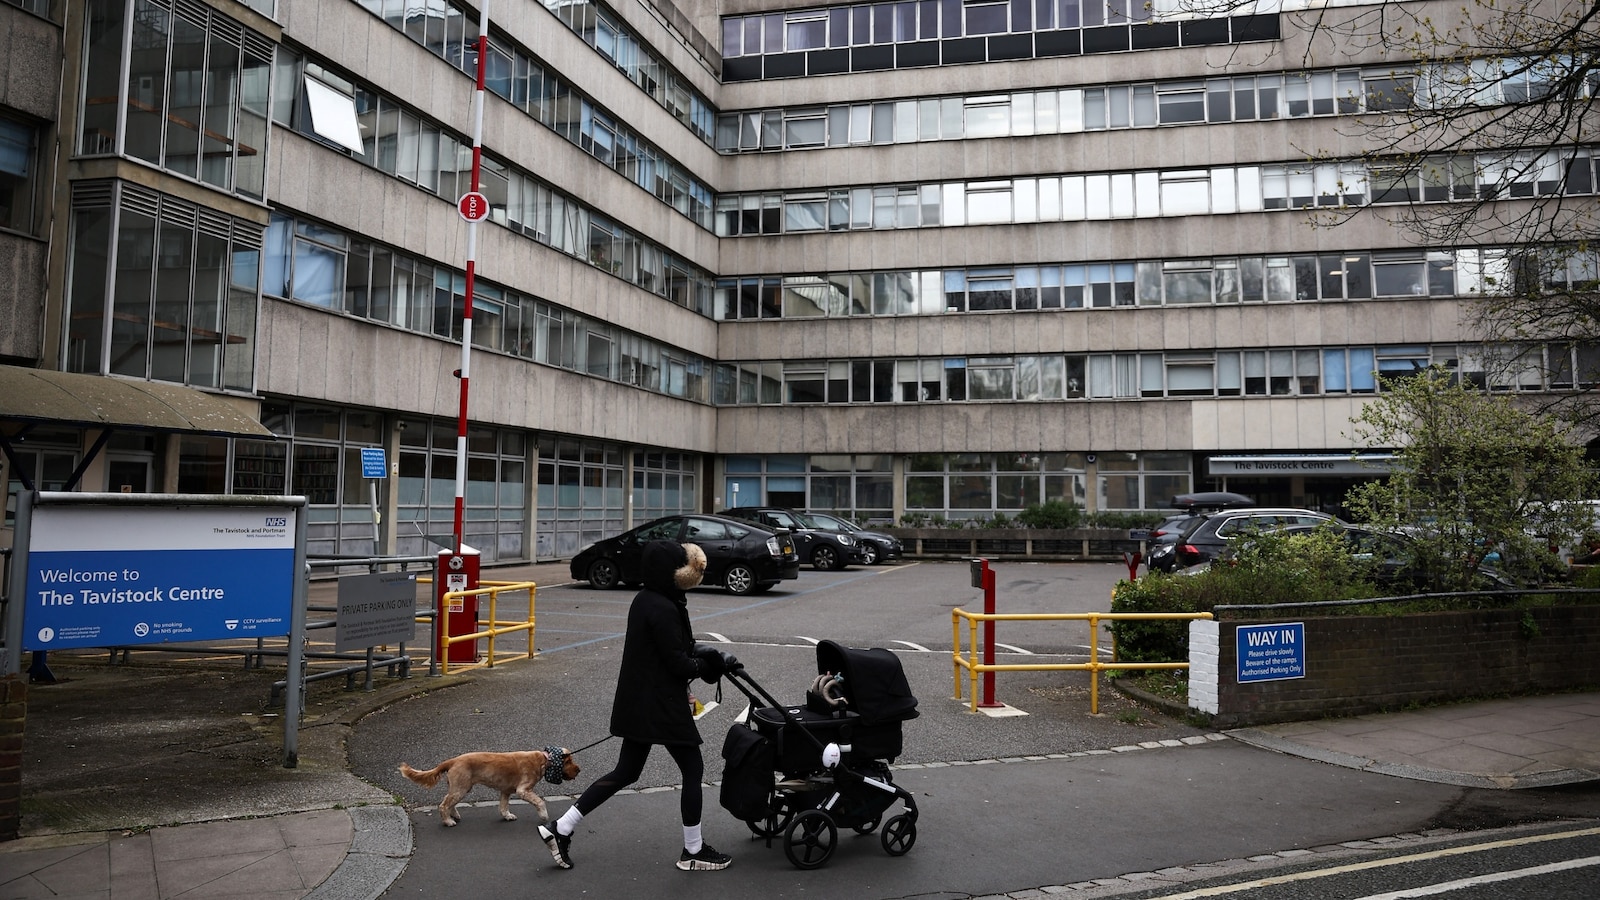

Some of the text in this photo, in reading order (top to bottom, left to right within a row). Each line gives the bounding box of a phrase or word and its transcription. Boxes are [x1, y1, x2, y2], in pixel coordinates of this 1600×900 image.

[469, 196, 477, 218] STOP
[1234, 461, 1334, 470] The Tavistock Centre
[266, 518, 286, 526] NHS
[40, 569, 139, 583] Welcome to
[39, 587, 224, 606] The Tavistock Centre
[342, 599, 412, 615] PRIVATE PARKING ONLY
[1248, 630, 1294, 646] WAY IN
[1242, 668, 1269, 676] Authorised
